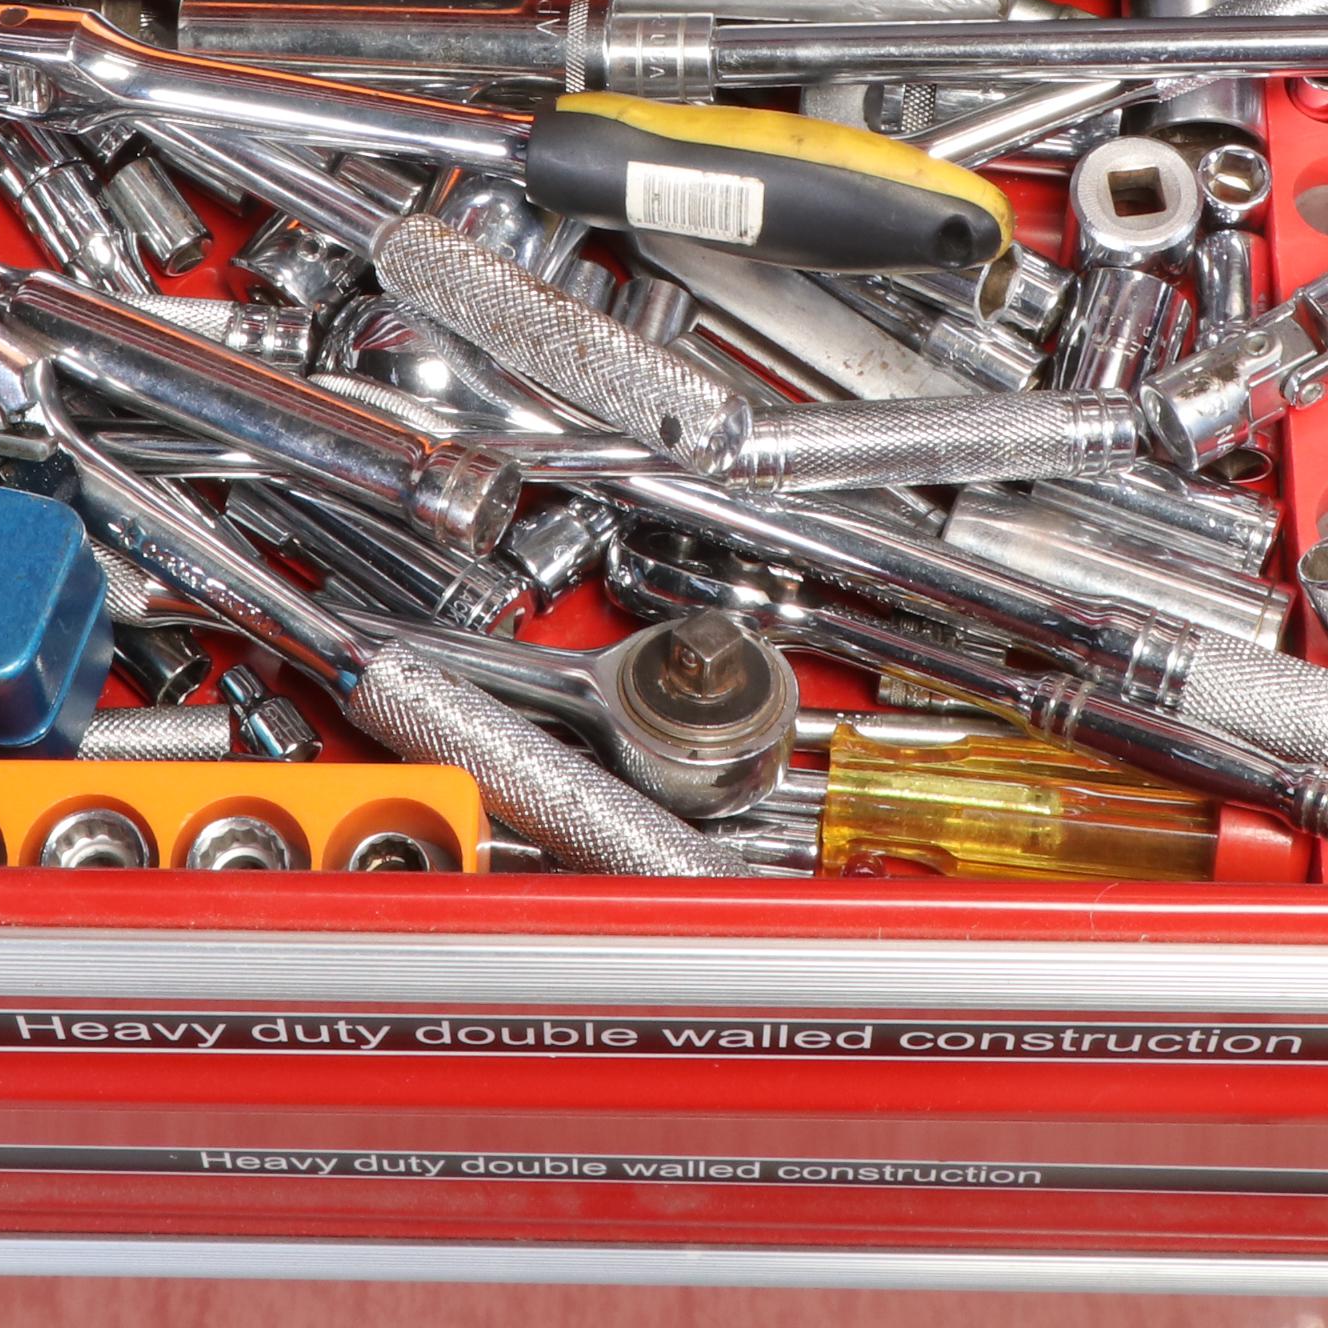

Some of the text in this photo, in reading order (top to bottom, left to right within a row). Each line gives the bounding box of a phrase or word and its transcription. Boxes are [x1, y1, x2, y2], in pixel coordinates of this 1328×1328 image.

[15, 1014, 1303, 1056] Heavy duty double walled construction
[200, 1151, 1042, 1185] Heavy duty double walled construction
